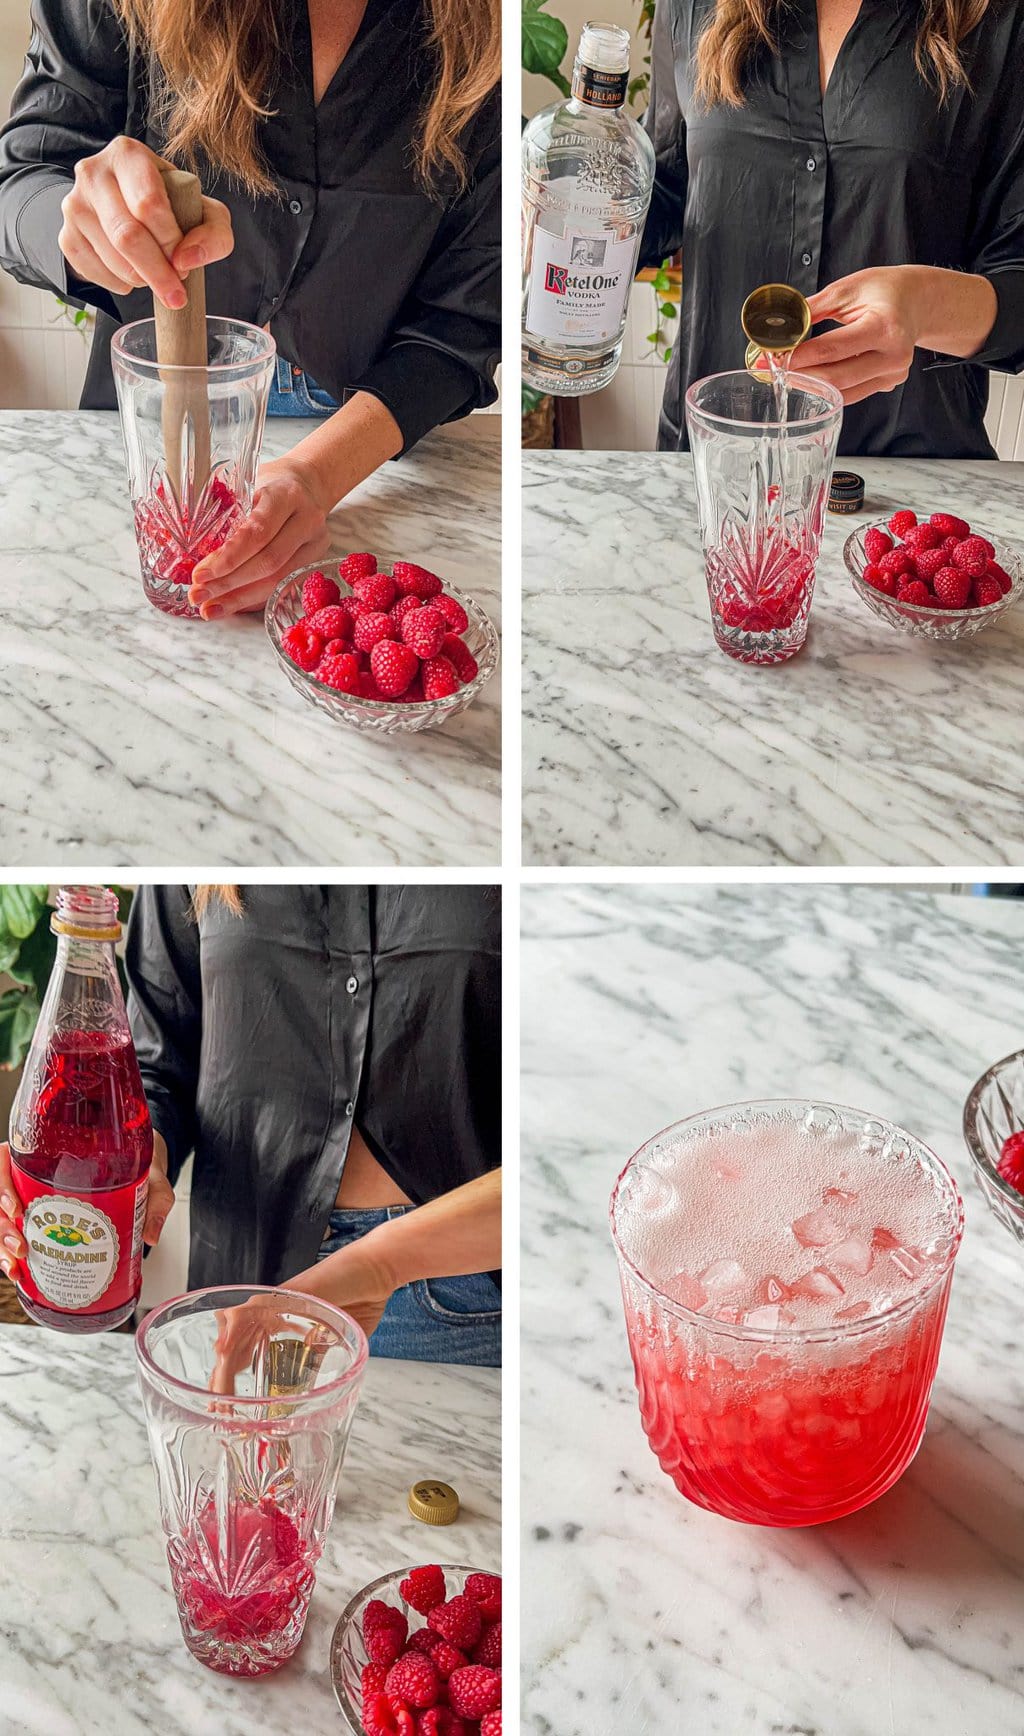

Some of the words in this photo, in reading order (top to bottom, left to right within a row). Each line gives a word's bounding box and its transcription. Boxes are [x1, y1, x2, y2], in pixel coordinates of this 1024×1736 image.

[586, 88, 622, 100] HOLLAND
[548, 265, 590, 293] Ketel
[592, 273, 619, 290] One
[556, 299, 584, 308] FAMILY
[567, 290, 601, 299] VODKA
[31, 1211, 106, 1241] ROSE'S
[31, 1239, 107, 1263] GRENADINE
